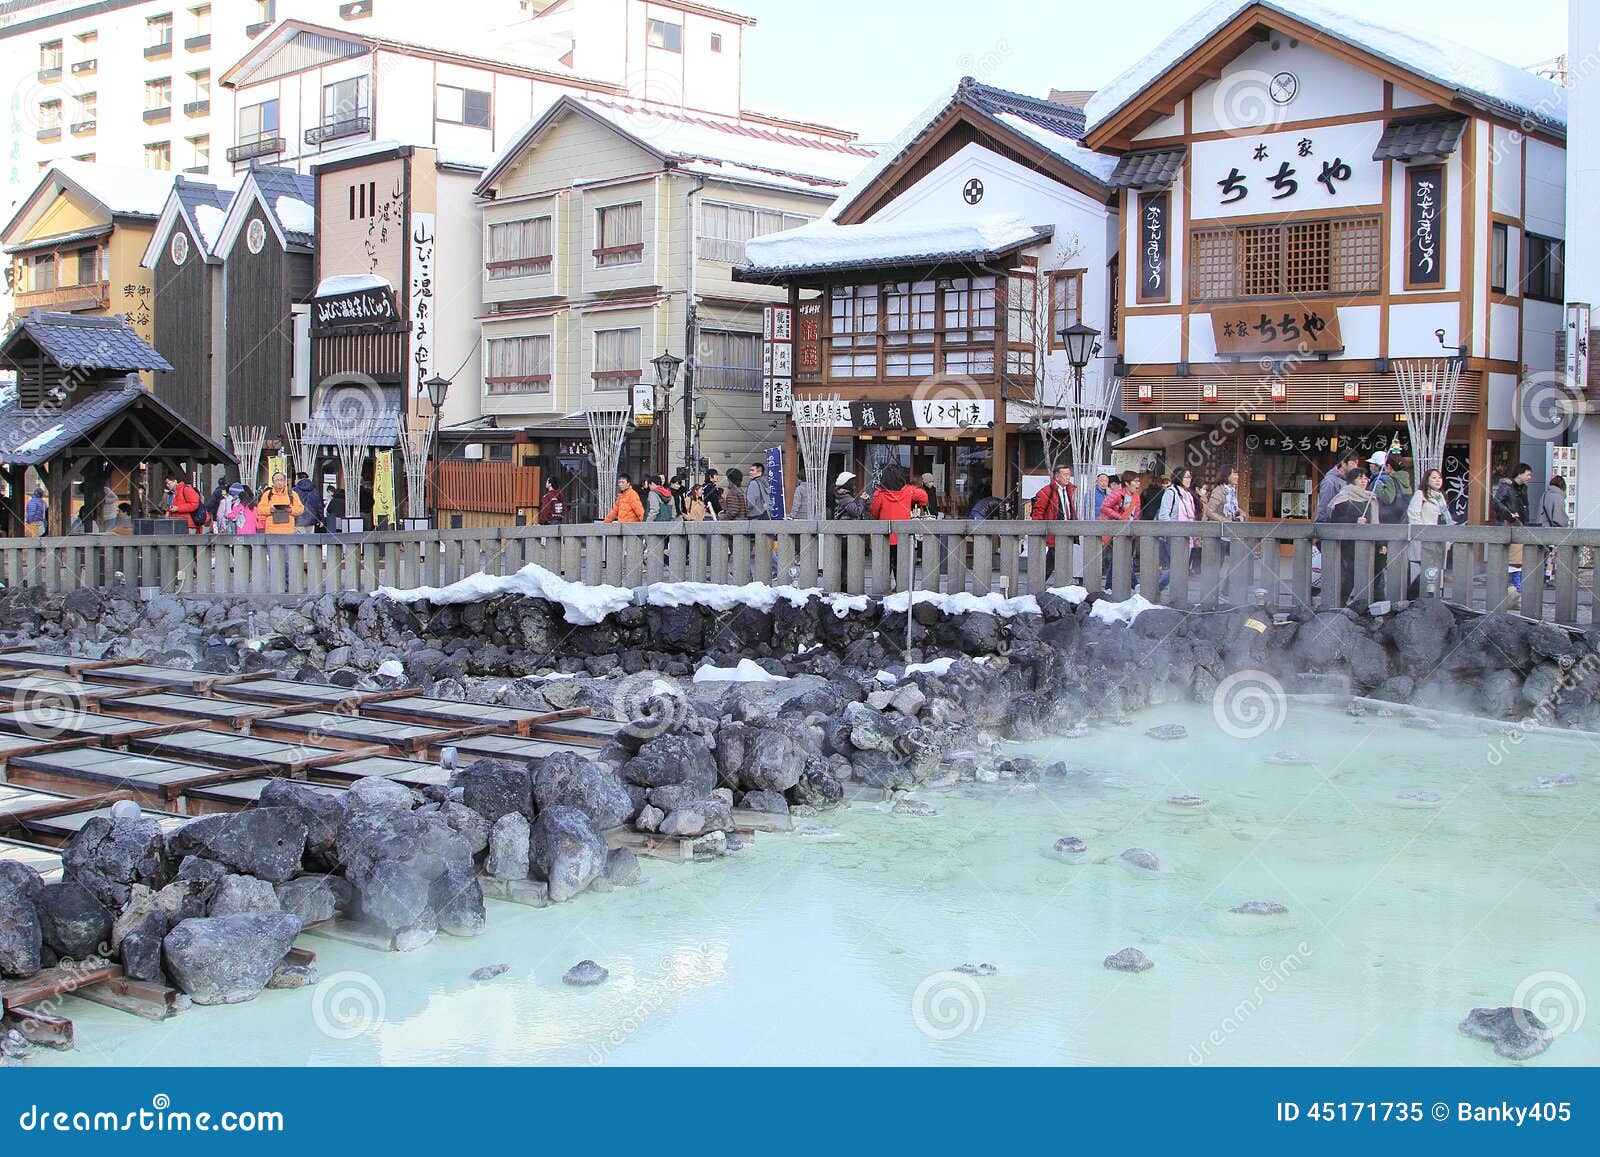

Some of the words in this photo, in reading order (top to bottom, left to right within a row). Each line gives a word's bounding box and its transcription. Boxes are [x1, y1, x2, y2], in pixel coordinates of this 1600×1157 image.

[1253, 137, 1313, 161] 本家
[1217, 157, 1352, 204] ちちや
[124, 283, 136, 325] 喫茶
[137, 285, 151, 326] 御入浴
[1223, 320, 1249, 338] 本家
[1253, 312, 1326, 343] ちちや
[1281, 436, 1328, 451] ちちや
